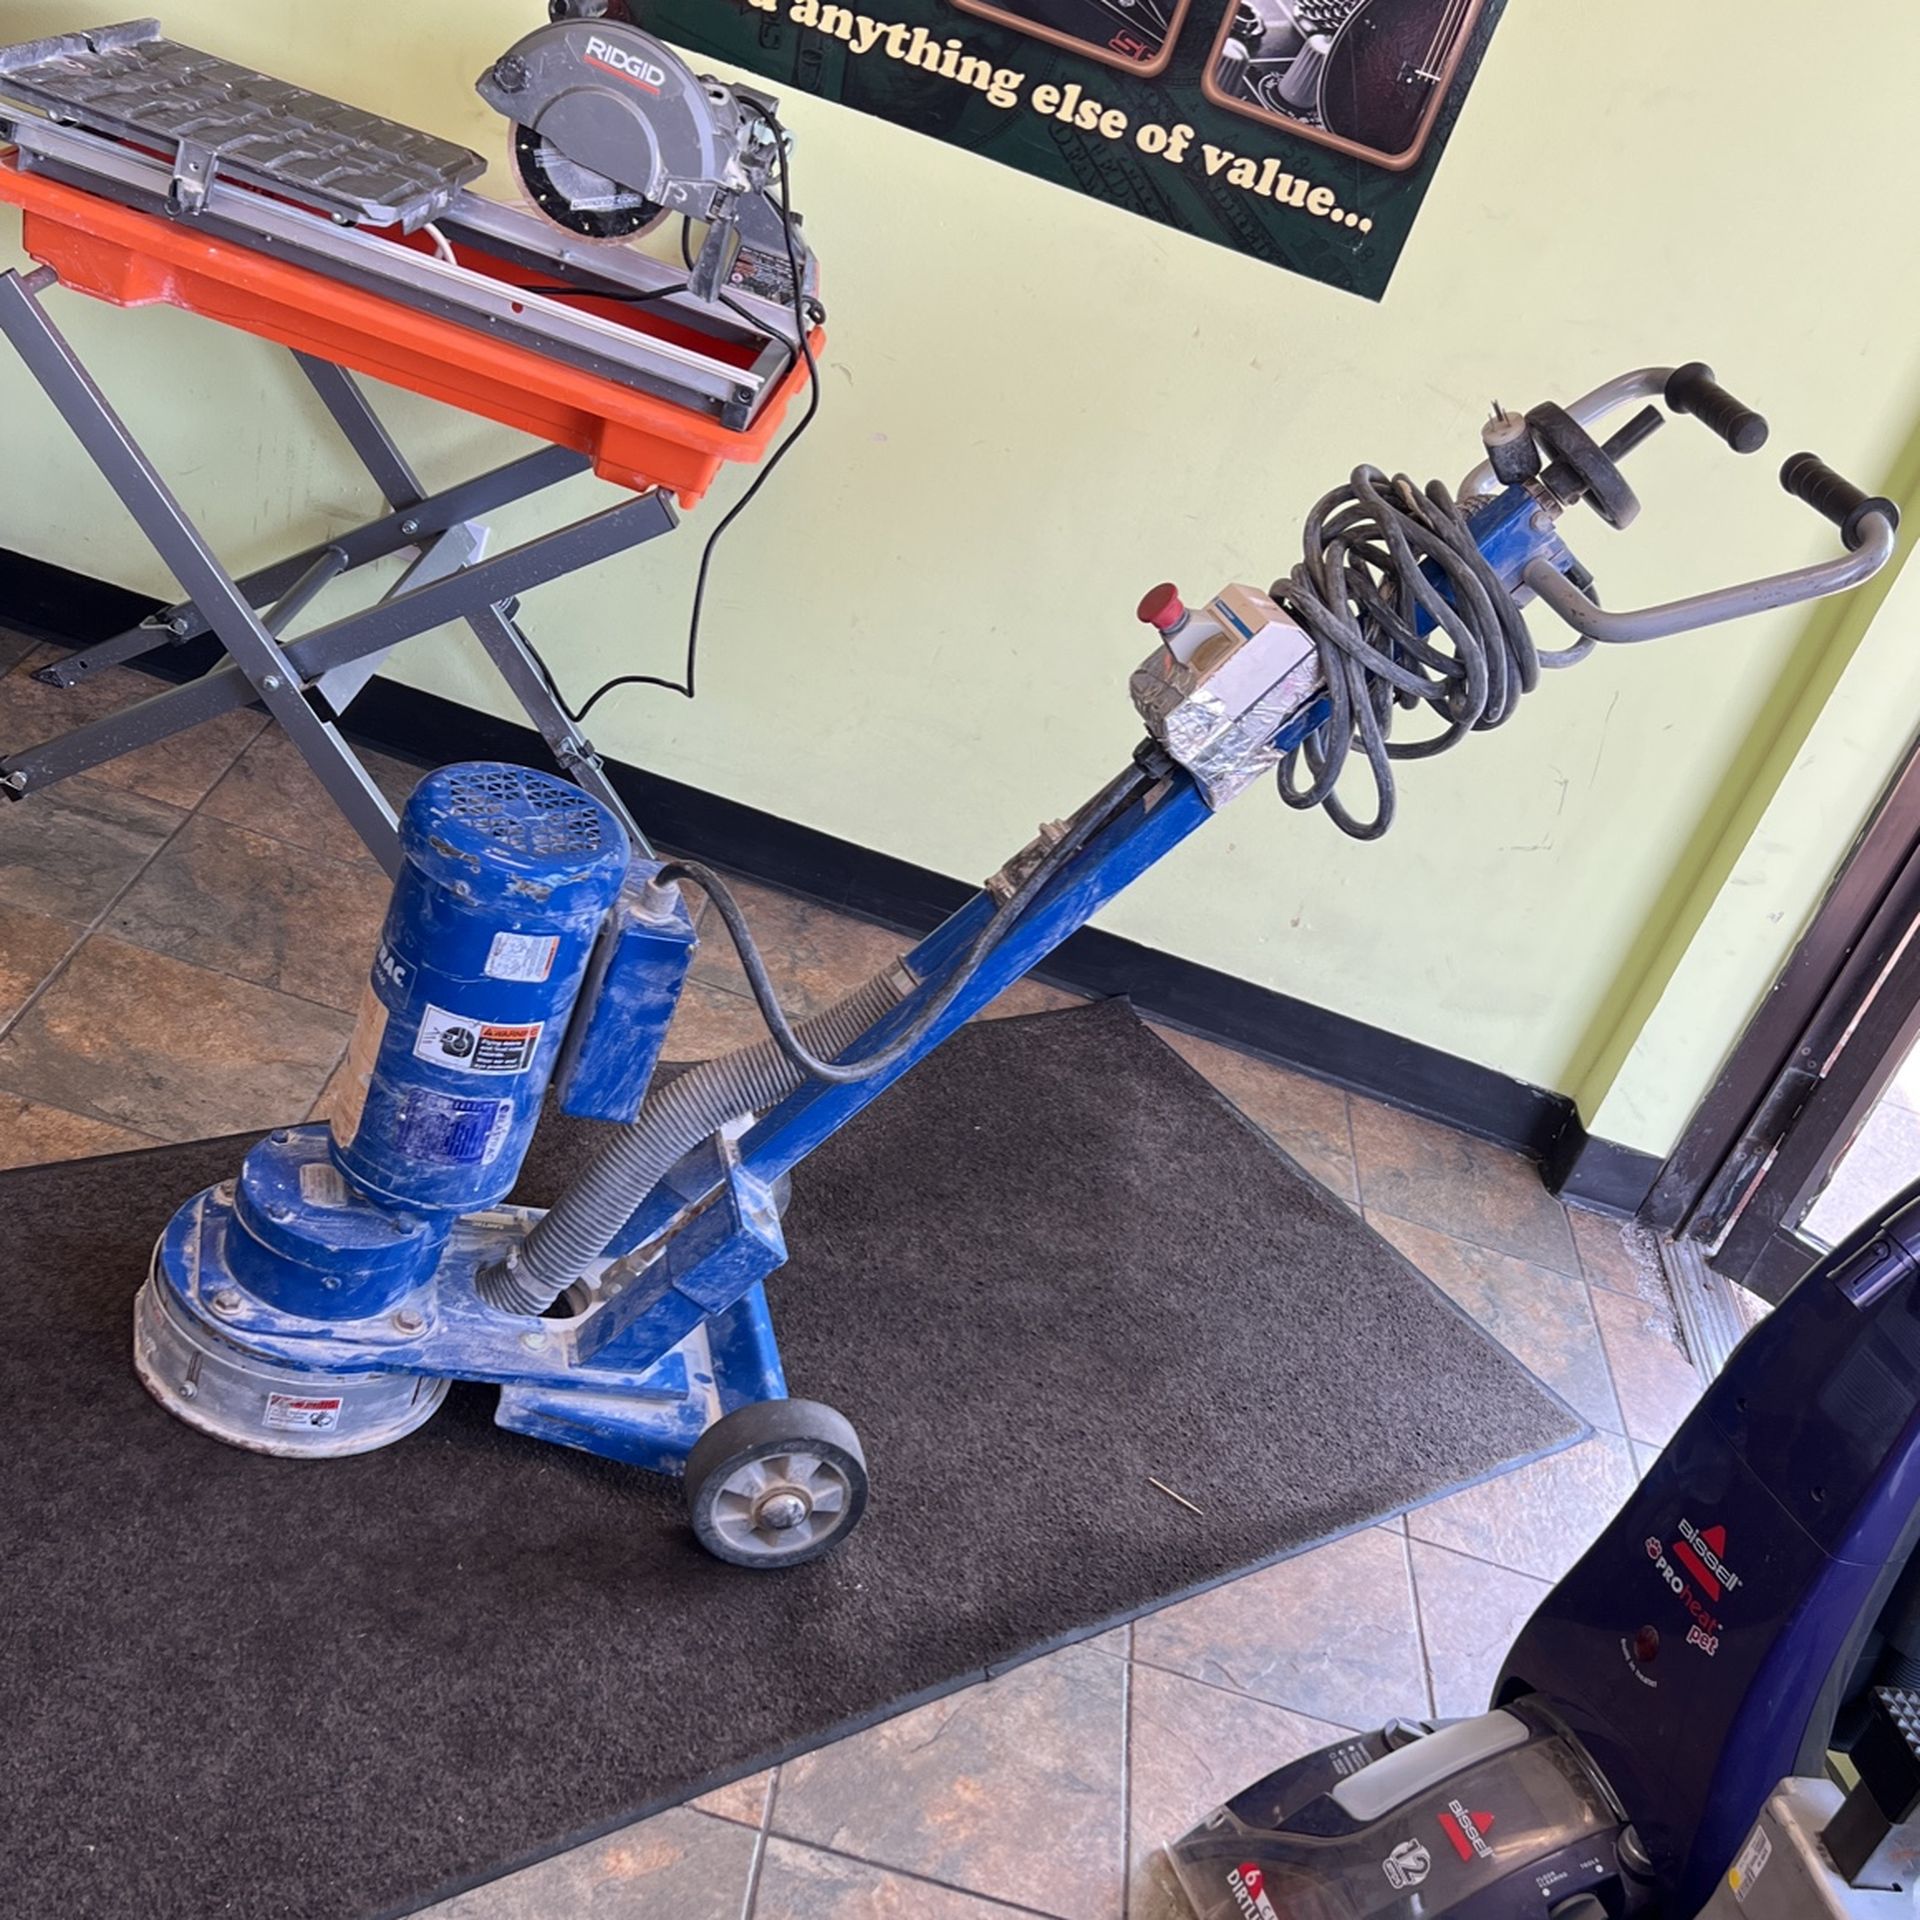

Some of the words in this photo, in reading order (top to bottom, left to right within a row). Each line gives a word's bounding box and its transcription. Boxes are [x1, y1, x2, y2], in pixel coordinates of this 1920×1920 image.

[585, 36, 666, 86] RIDGID
[789, 0, 1026, 108] anything
[1031, 83, 1129, 139] else
[1135, 124, 1195, 163] of
[1201, 143, 1373, 233] value...
[1686, 1624, 1719, 1657] pet
[1244, 1869, 1262, 1887] 6
[1395, 1838, 1430, 1883] 12
